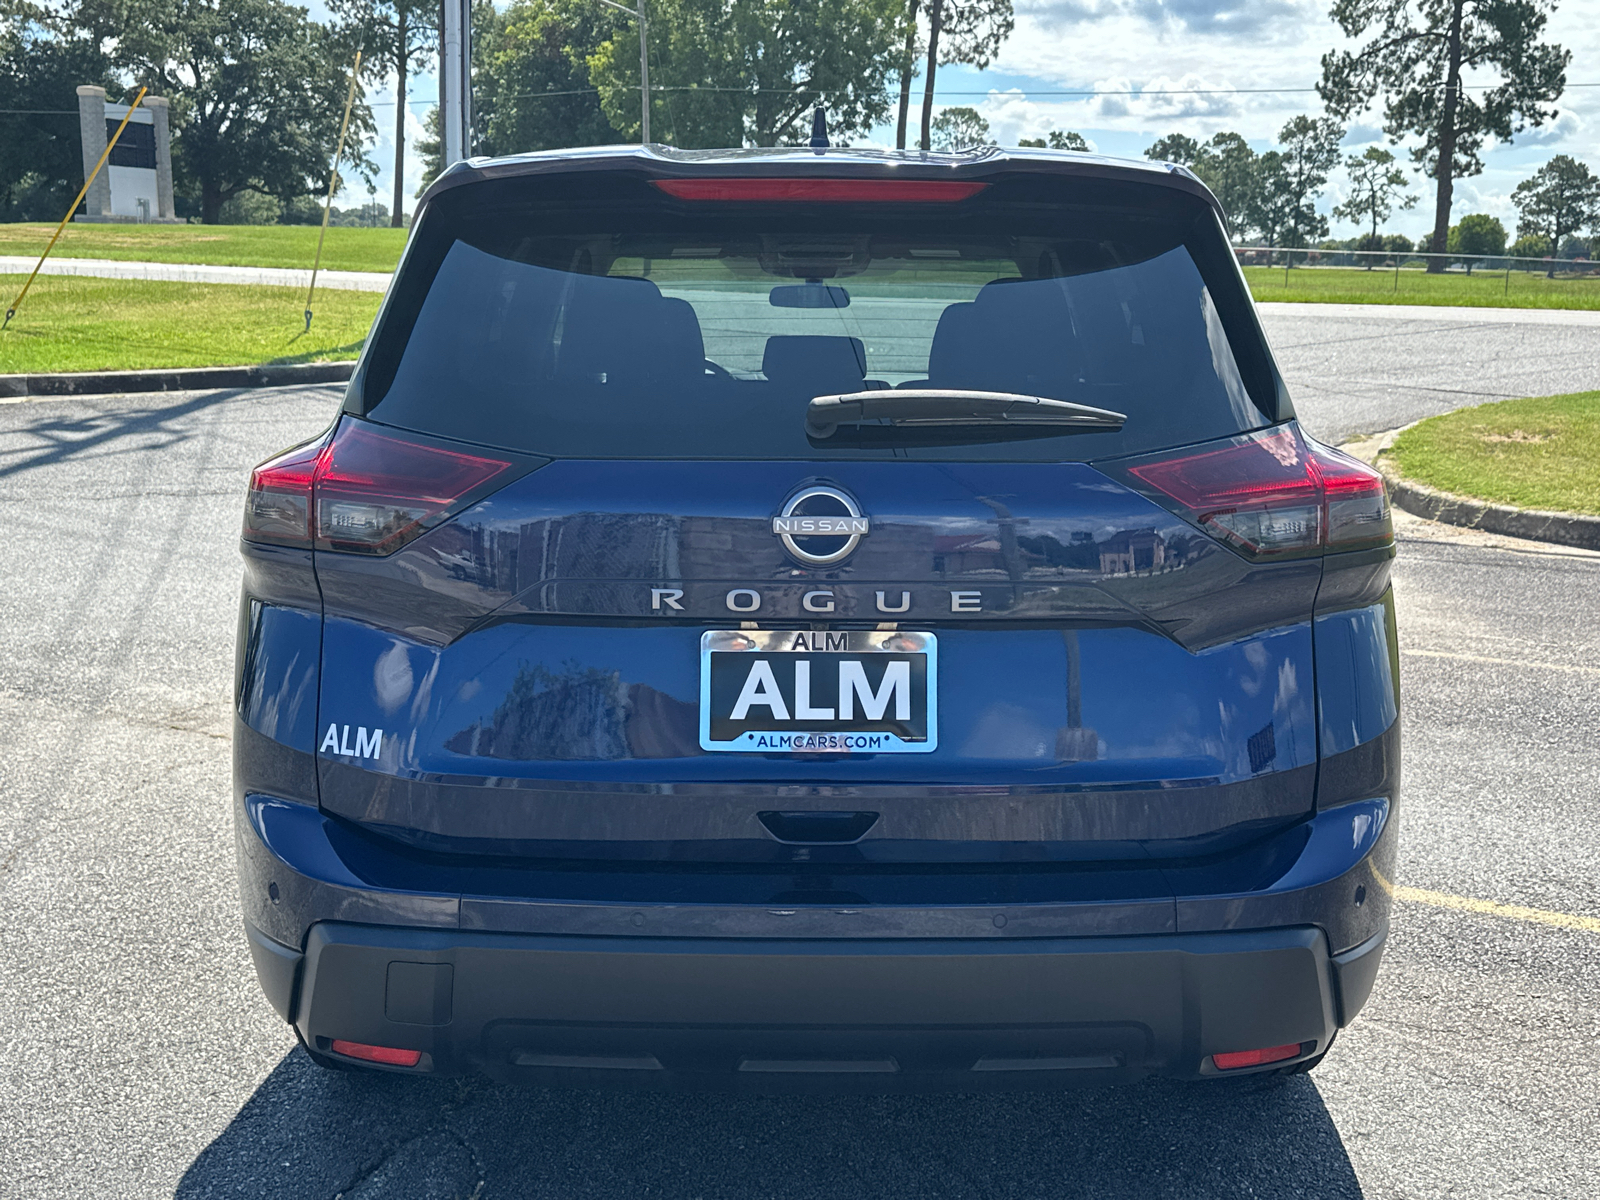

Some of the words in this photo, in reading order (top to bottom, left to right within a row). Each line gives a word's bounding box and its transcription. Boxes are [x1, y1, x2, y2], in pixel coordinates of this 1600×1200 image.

[776, 520, 866, 532] NISSAN
[651, 589, 982, 612] ROGUE
[791, 632, 848, 651] ALM
[729, 660, 911, 721] ALM
[320, 723, 383, 760] ALM
[757, 735, 881, 749] ALMCARS.COM
